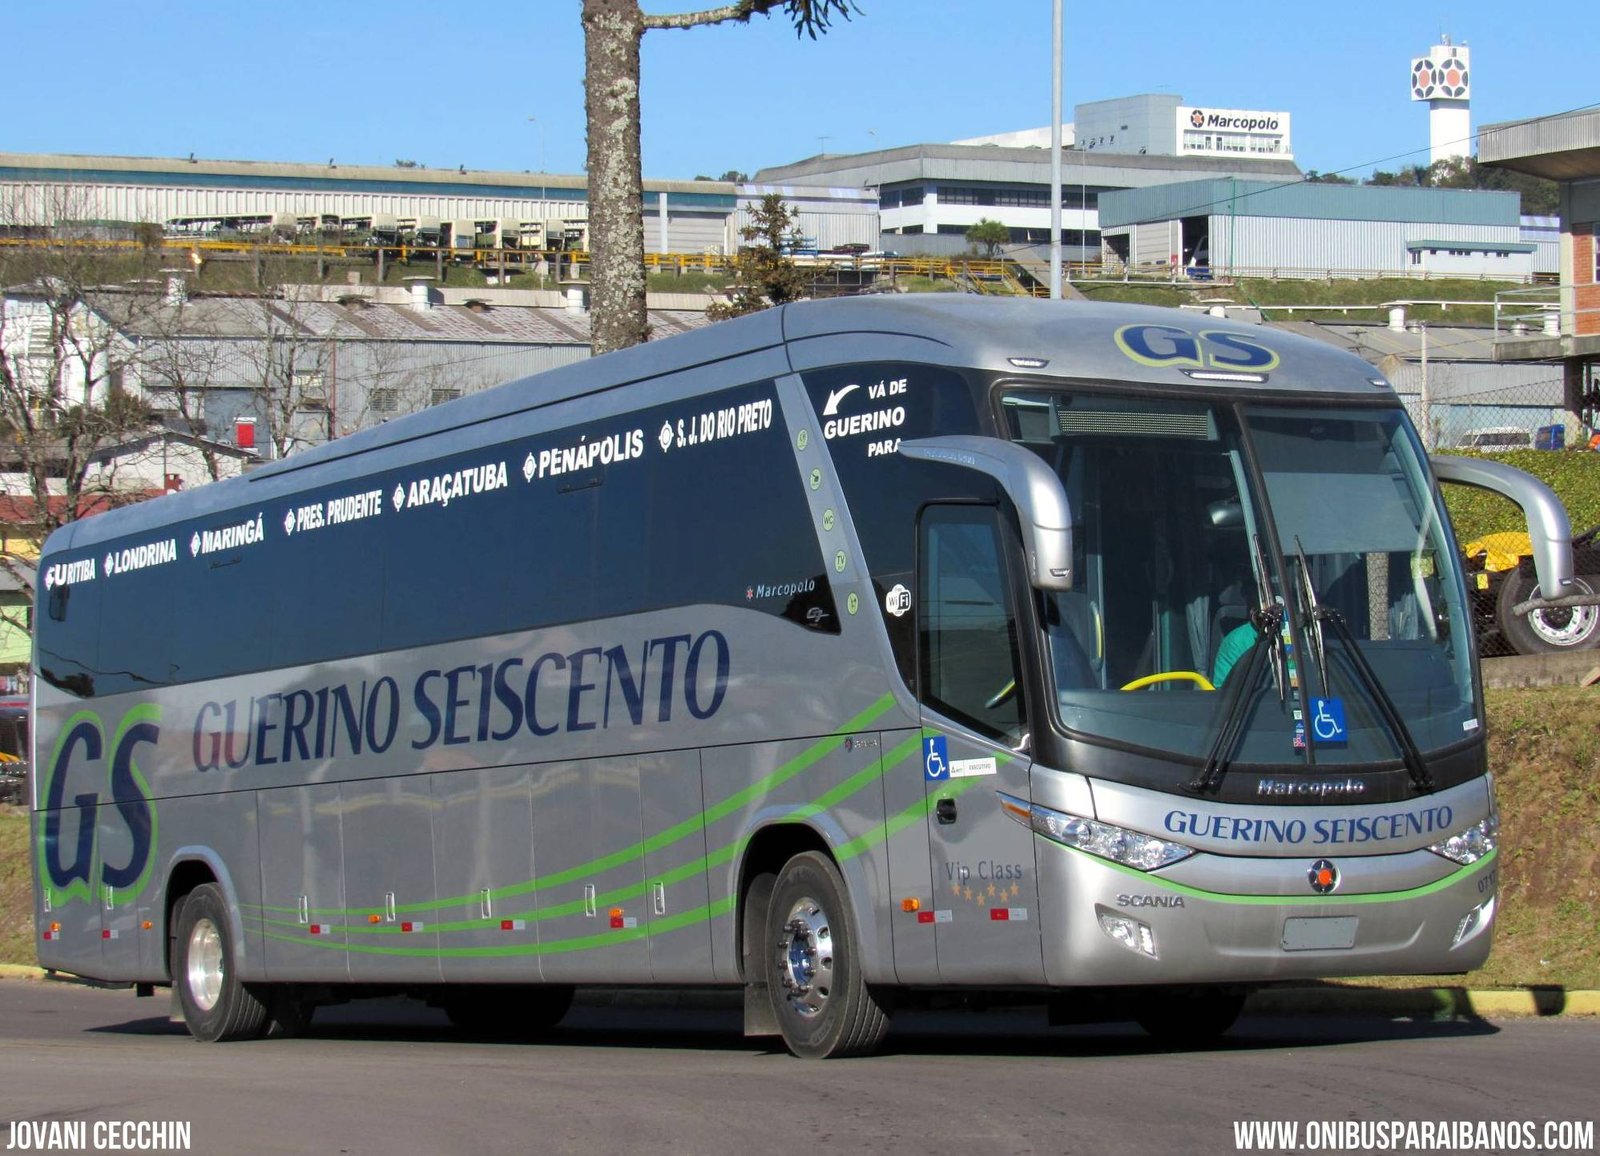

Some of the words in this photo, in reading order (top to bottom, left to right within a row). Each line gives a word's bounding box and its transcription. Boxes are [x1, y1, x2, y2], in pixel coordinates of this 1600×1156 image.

[1207, 115, 1279, 131] Marcopolo
[1118, 324, 1276, 370] GS
[868, 381, 886, 399] VÁ
[889, 379, 907, 396] DE
[677, 418, 686, 448] S.
[688, 416, 698, 445] J.
[700, 411, 716, 443] DO
[717, 407, 736, 439] RIO
[738, 398, 773, 435] PRETO
[824, 407, 906, 440] GUERINO
[539, 428, 644, 478] PENÁPOLIS
[407, 461, 509, 508] ARAÇATUBA
[296, 501, 325, 532] PRES.
[327, 489, 382, 525] PRUDENTE
[824, 516, 834, 525] WC
[202, 512, 264, 554] MARINGÁ
[114, 538, 177, 574] LONDRINA
[755, 579, 815, 599] Marcopolo
[192, 674, 401, 773] GUERINO
[411, 629, 731, 750] SEISCENTO
[43, 718, 161, 892] GS
[1257, 779, 1365, 796] Marcopolo
[1164, 810, 1306, 844] GUERINO
[1313, 806, 1453, 844] SEISCENTO
[945, 861, 971, 885] Vip
[978, 860, 1023, 880] Class
[1115, 894, 1185, 908] SCANIA
